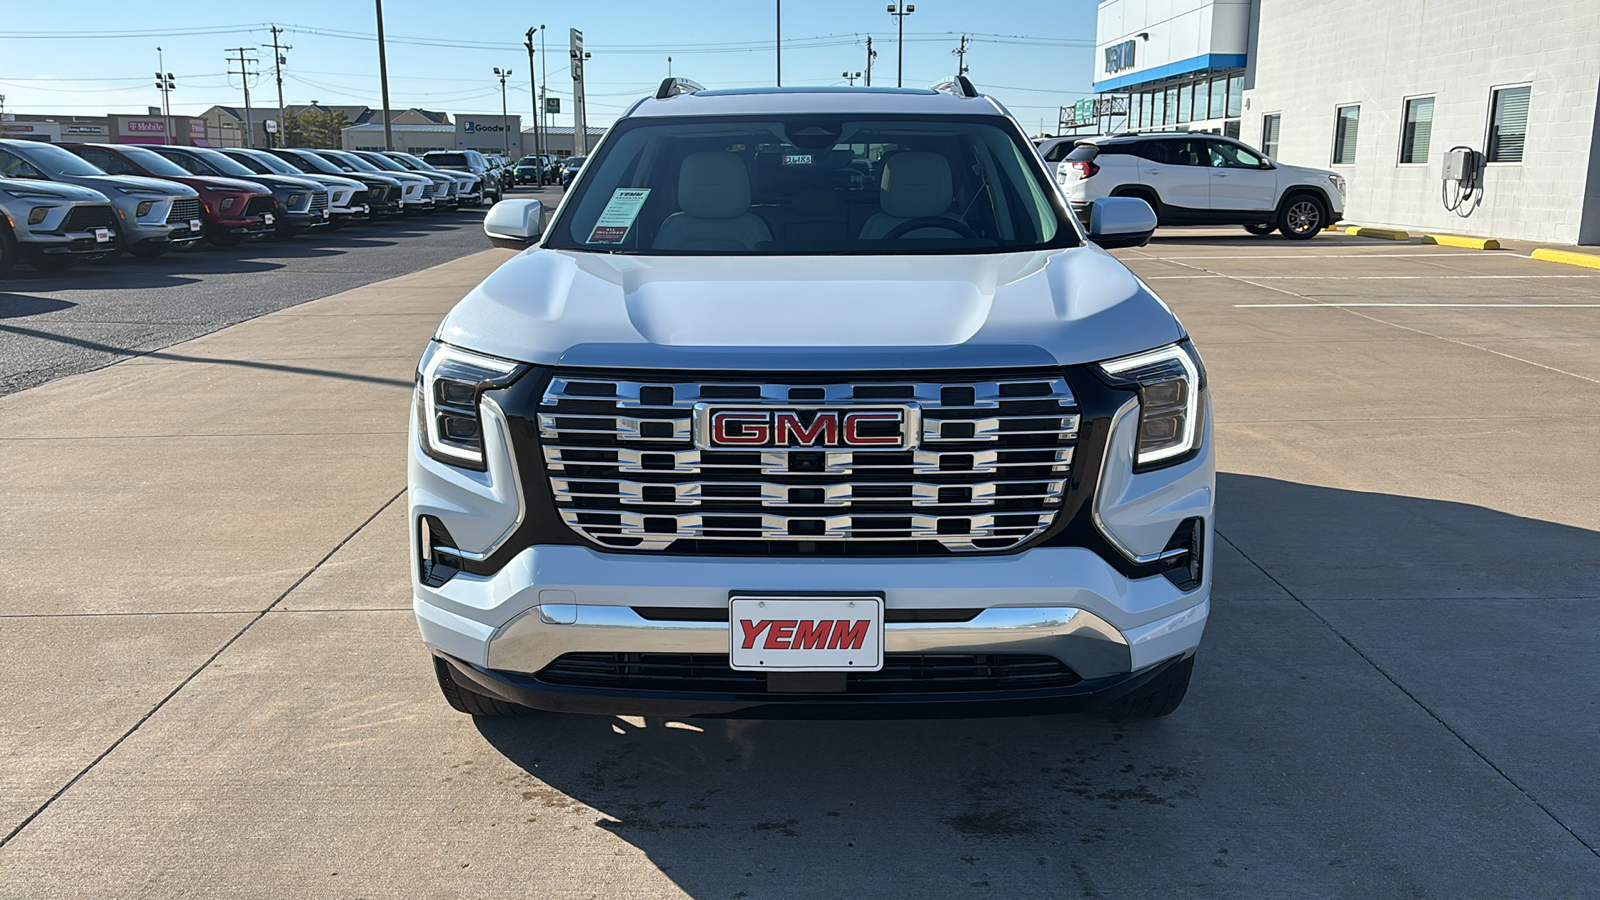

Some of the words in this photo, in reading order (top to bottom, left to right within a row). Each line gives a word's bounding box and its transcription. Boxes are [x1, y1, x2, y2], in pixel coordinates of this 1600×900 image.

[137, 122, 164, 131] Mobile
[475, 124, 510, 132] Goodwll
[712, 410, 902, 446] GMC
[739, 619, 871, 650] YEMM
